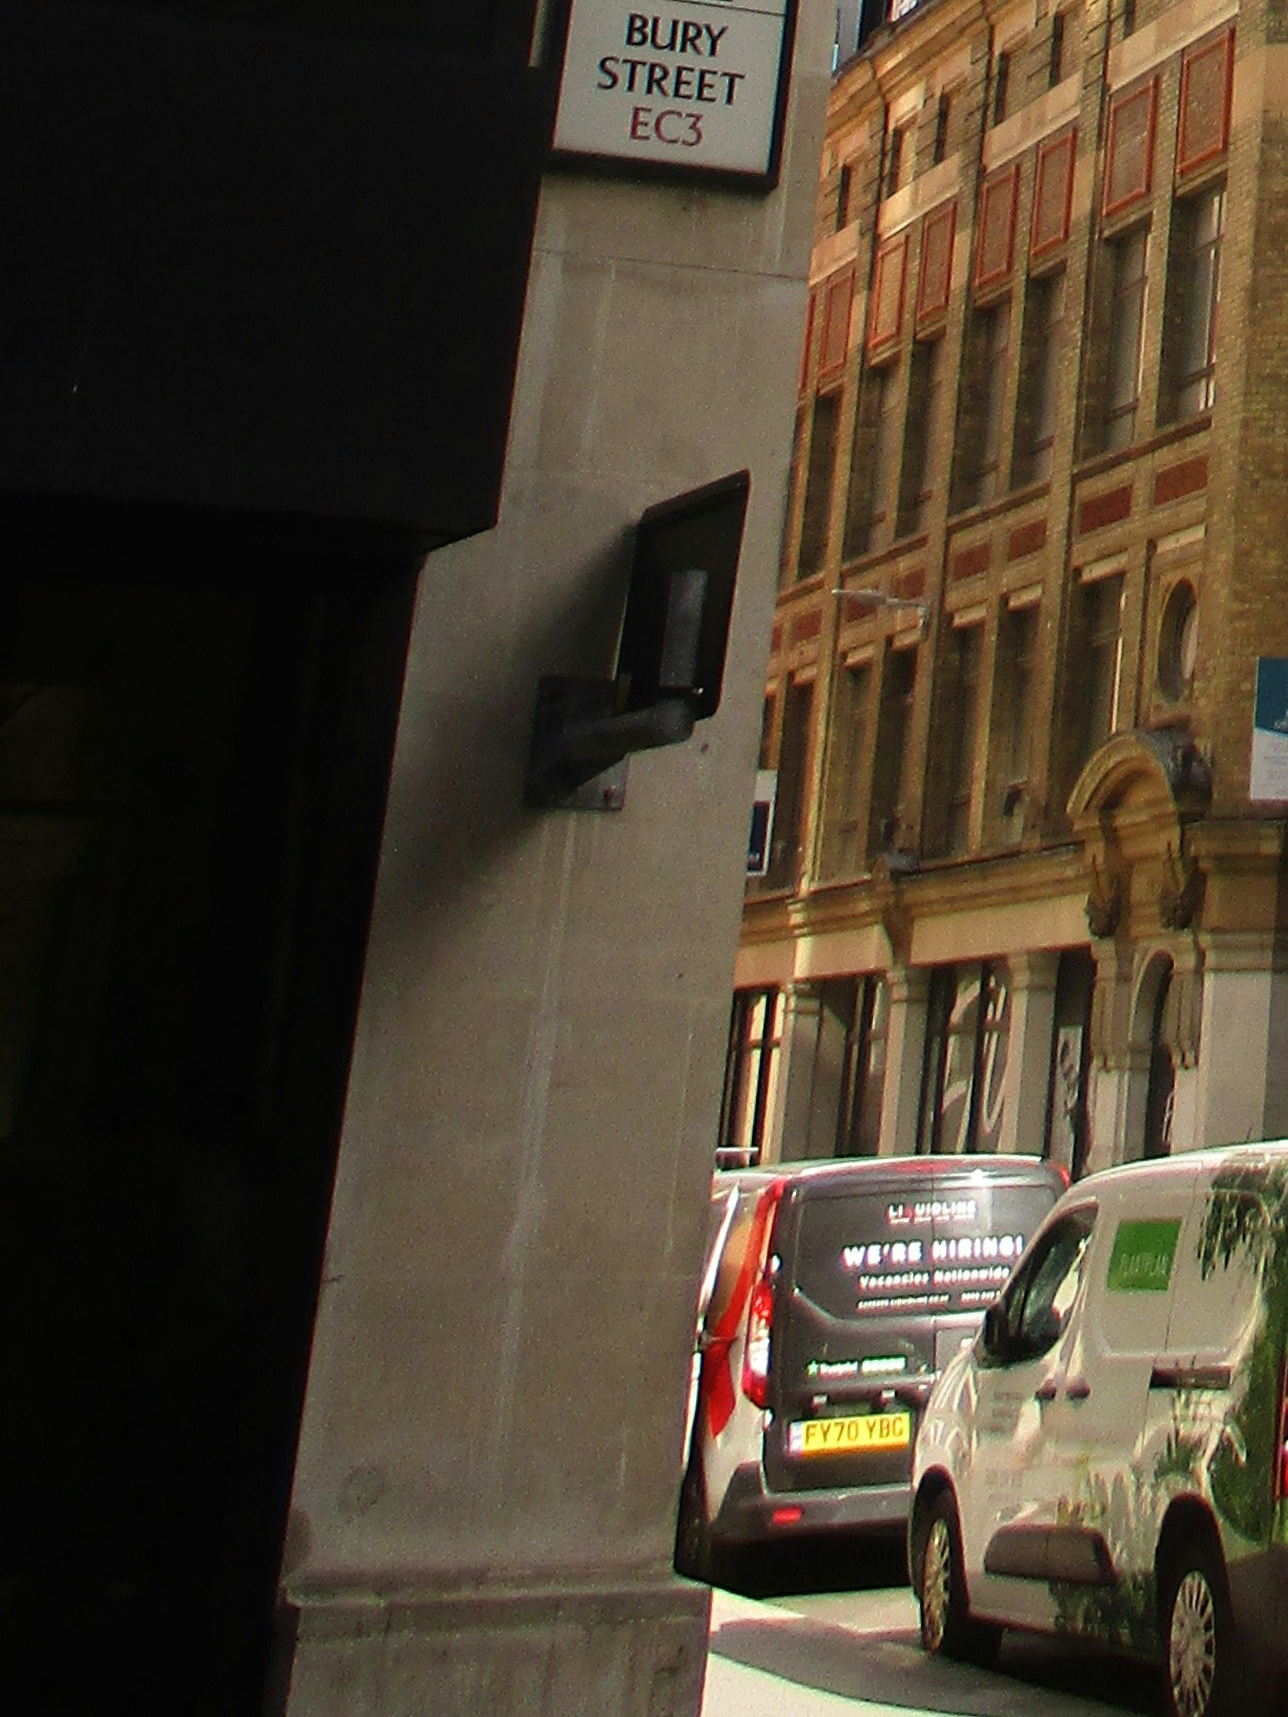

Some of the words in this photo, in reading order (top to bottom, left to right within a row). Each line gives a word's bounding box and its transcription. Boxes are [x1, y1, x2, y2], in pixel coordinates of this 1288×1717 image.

[625, 13, 729, 58] BURY
[597, 55, 746, 107] STREET
[629, 106, 704, 147] EC3
[843, 1241, 923, 1267] WE'RE
[932, 1234, 1024, 1261] HIRING!
[860, 1270, 929, 1290] Vacancies
[934, 1266, 1010, 1284] Nationwide
[805, 1421, 859, 1446] FY70
